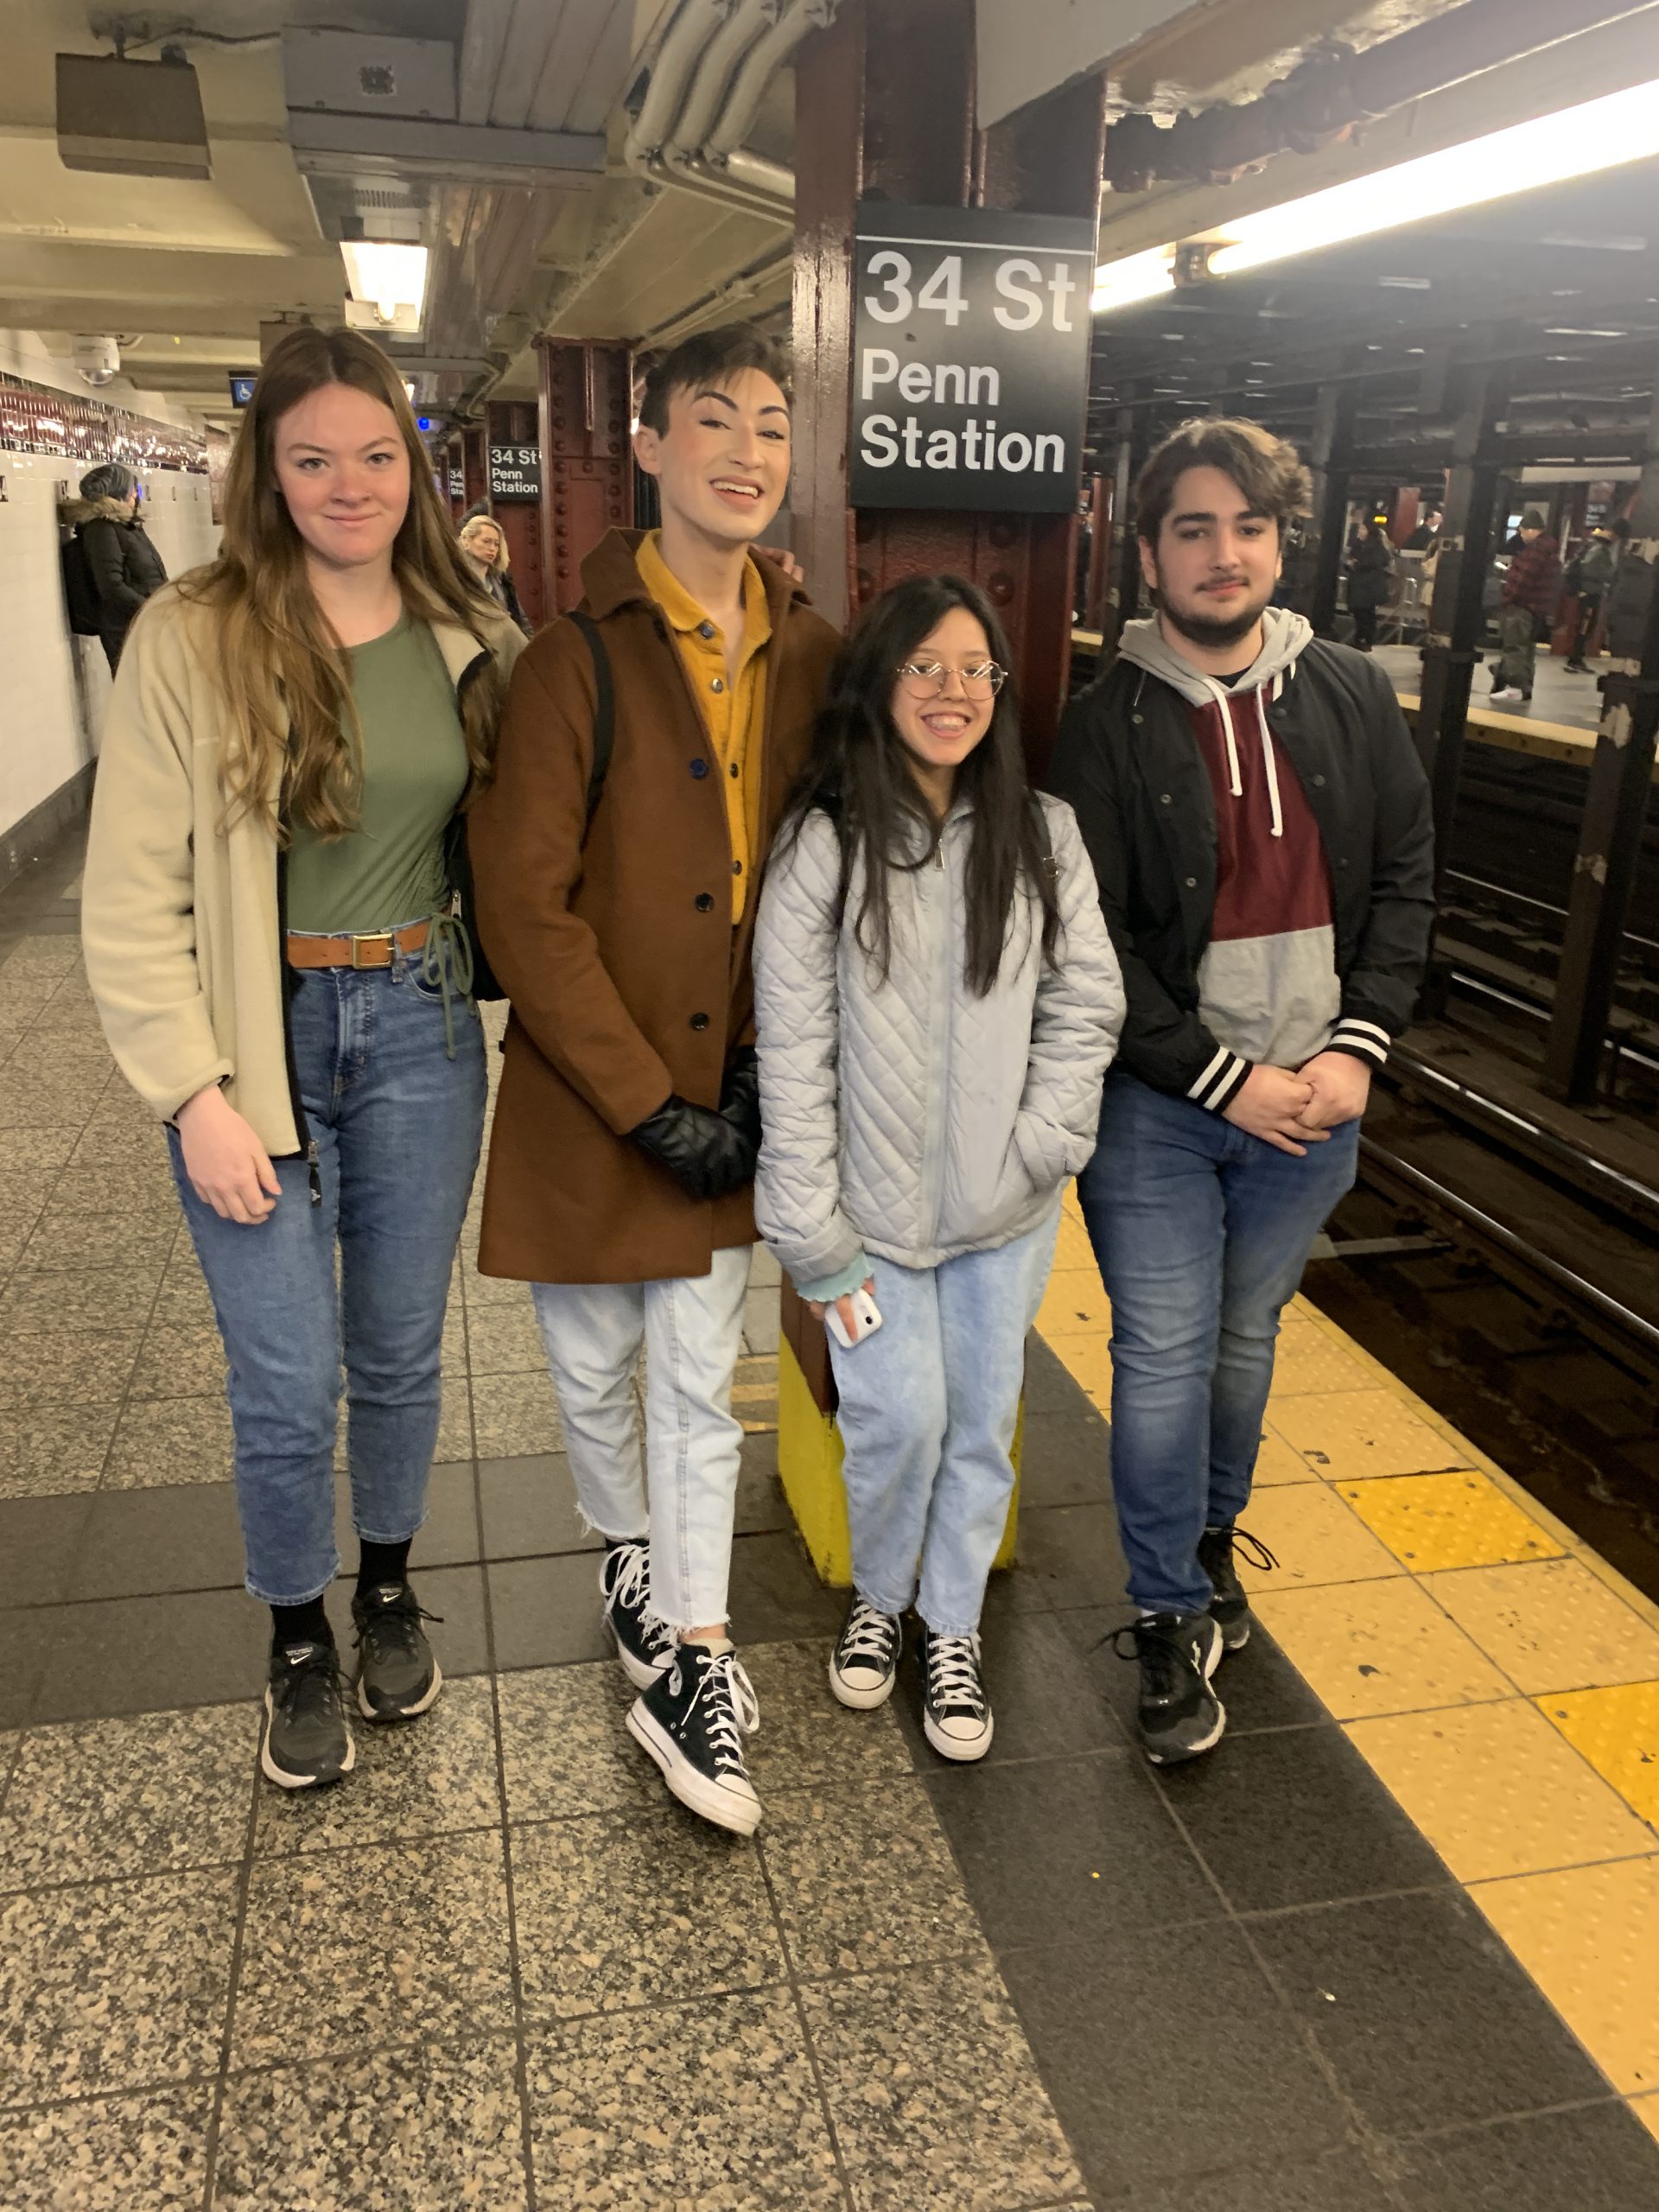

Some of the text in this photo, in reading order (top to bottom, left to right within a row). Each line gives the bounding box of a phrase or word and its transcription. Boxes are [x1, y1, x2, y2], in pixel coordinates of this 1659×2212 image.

[864, 251, 1076, 332] 34 St
[861, 348, 1000, 405] Penn
[861, 414, 1065, 473] Station
[492, 448, 537, 465] 34 St
[450, 470, 462, 479] 34
[492, 467, 523, 480] Penn
[493, 480, 538, 493] Station
